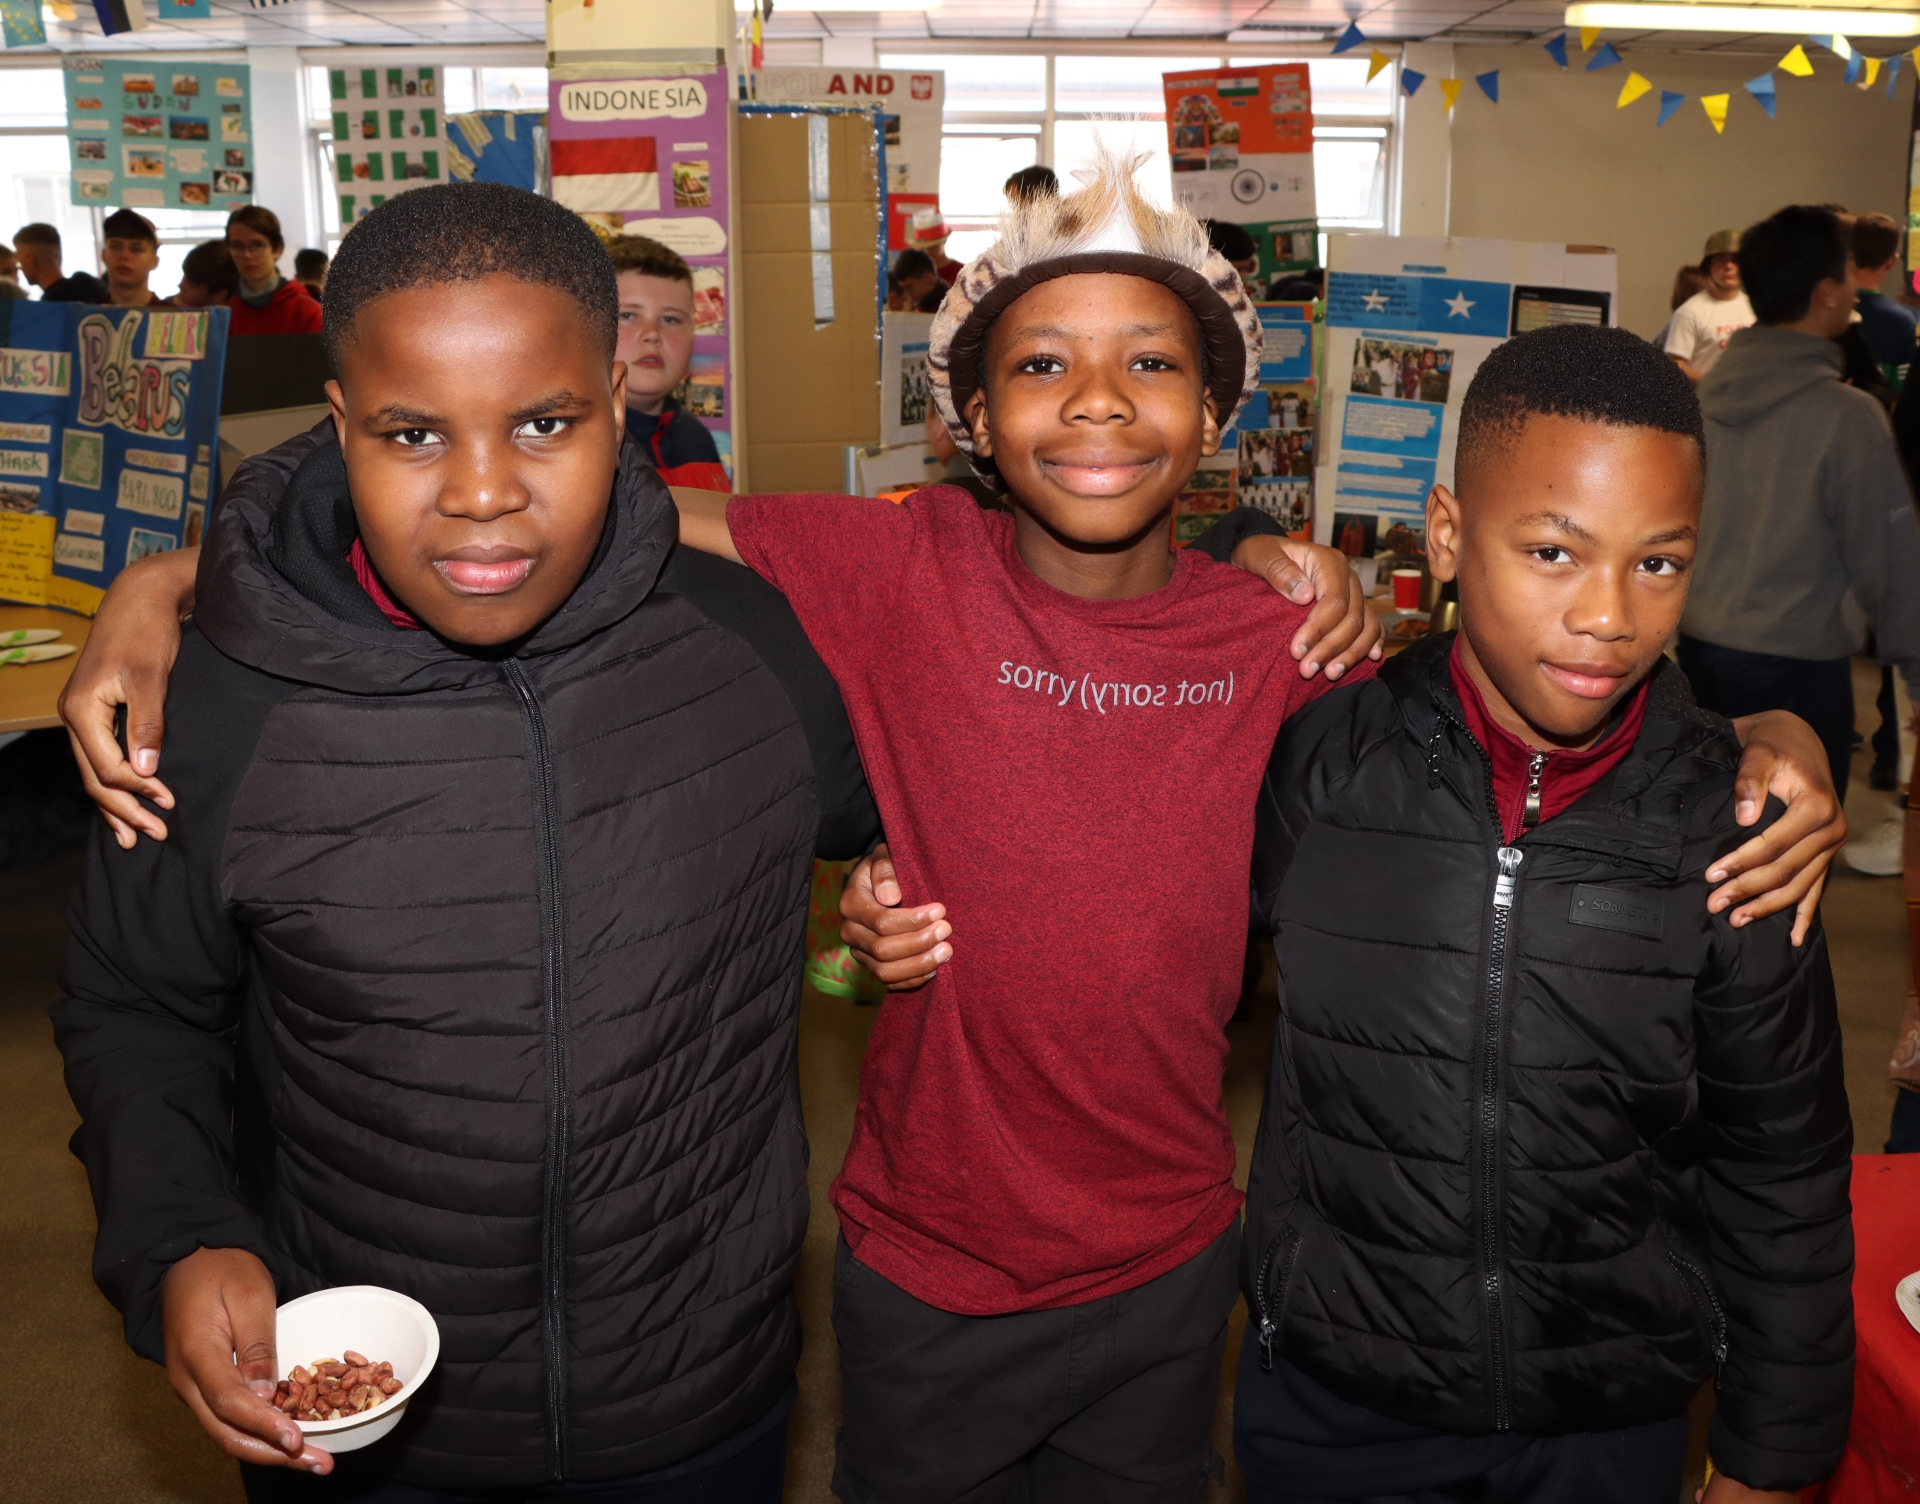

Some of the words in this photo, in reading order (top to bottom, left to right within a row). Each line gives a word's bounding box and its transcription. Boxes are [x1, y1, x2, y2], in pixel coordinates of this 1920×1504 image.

[123, 95, 191, 111] SUDAN
[568, 86, 702, 111] INDONESIA
[0, 352, 67, 388] USSIA
[997, 661, 1077, 707] sorry
